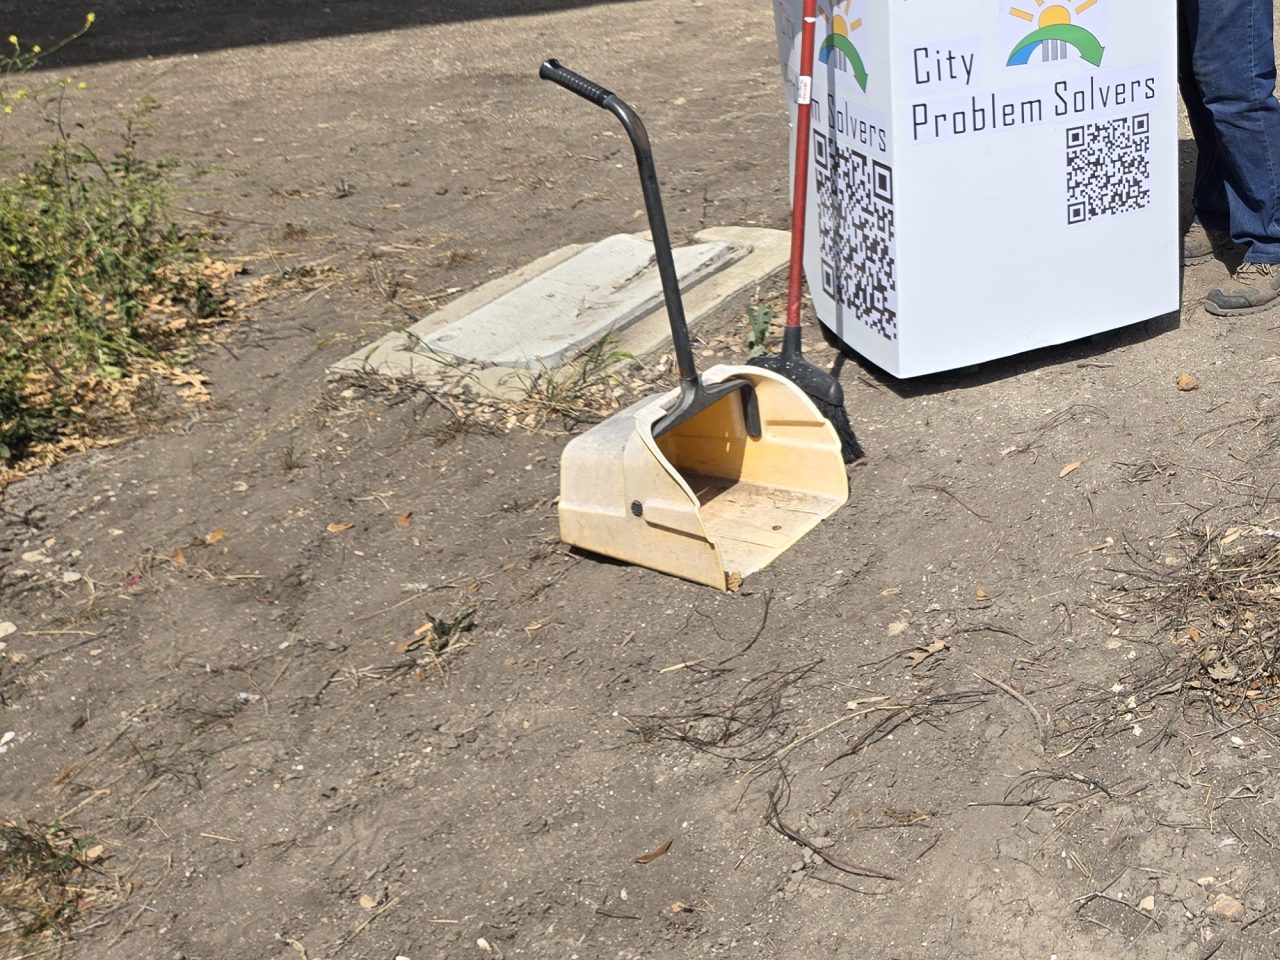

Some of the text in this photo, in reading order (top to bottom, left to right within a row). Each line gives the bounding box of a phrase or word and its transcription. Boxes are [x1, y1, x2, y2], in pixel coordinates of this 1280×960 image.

[913, 47, 974, 86] City
[827, 93, 886, 152] Solvers
[912, 76, 1155, 140] Problem Solvers
